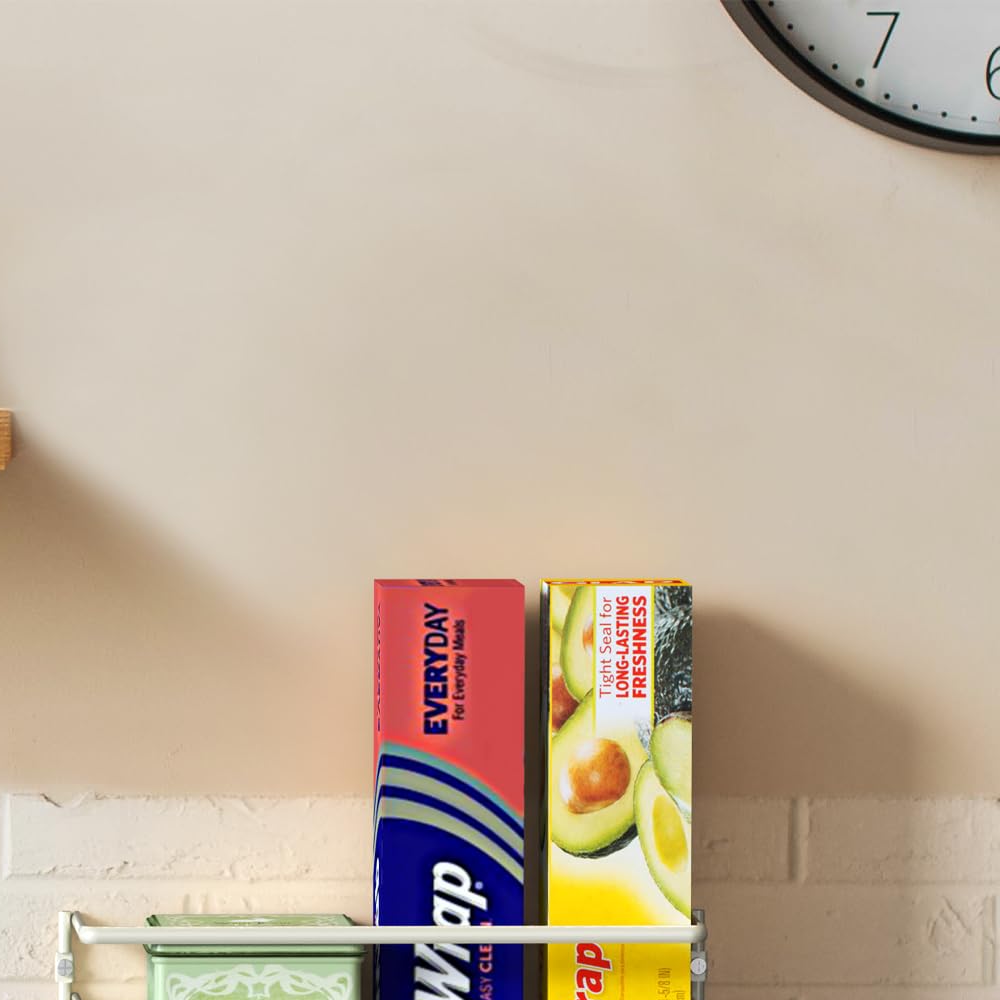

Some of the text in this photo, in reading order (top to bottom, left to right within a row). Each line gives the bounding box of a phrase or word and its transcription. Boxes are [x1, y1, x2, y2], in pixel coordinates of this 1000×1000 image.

[866, 11, 900, 69] 7
[424, 602, 448, 735] EVERYDAY
[452, 619, 467, 720] For Everyday Meals
[599, 597, 615, 699] Tight Seal for
[615, 595, 629, 698] LONG-LASTING
[632, 595, 647, 698] FRESHNESS
